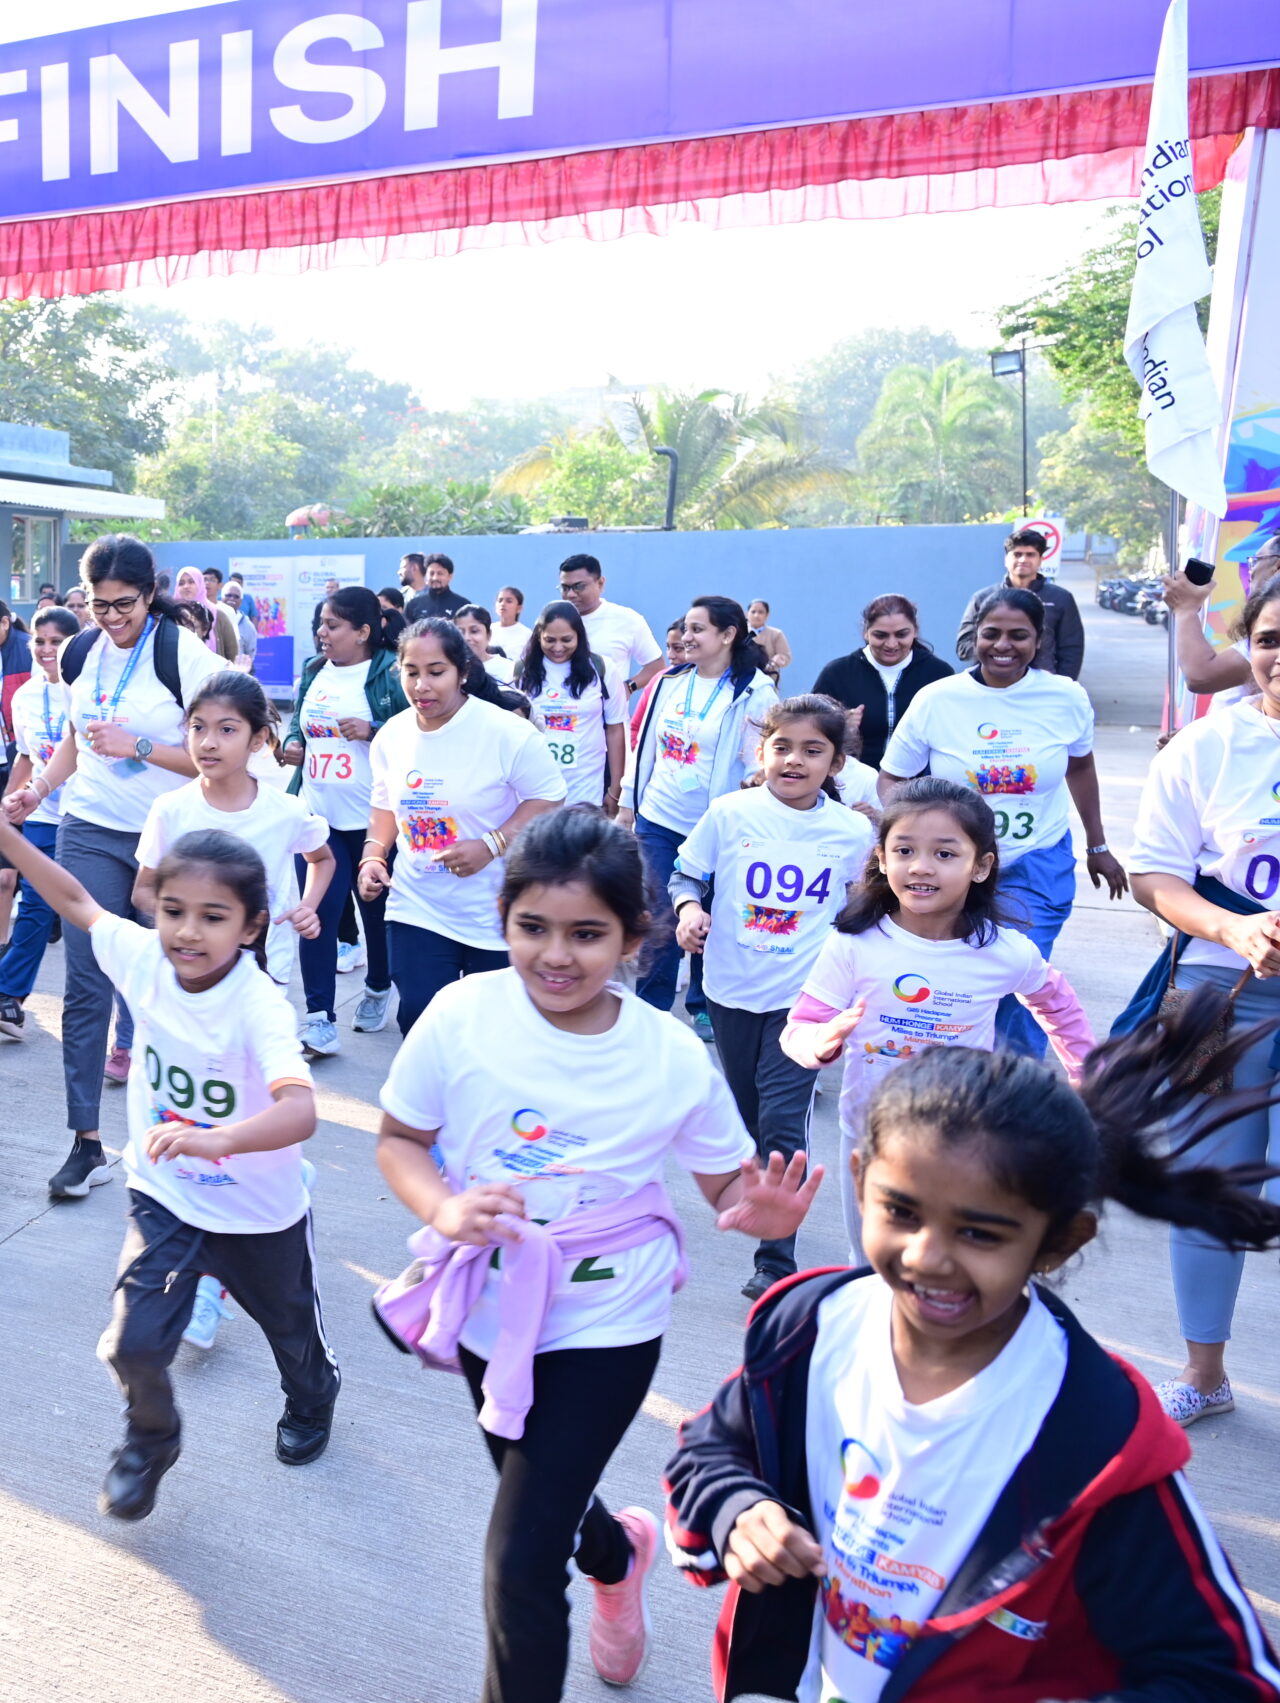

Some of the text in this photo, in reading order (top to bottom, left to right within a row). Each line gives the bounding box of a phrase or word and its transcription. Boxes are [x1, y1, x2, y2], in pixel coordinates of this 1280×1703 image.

[309, 753, 352, 779] 073
[746, 861, 832, 904] 094
[933, 995, 972, 1004] International
[934, 989, 954, 997] Global
[880, 1015, 901, 1025] HUM
[902, 1018, 932, 1031] HONGE
[891, 1026, 959, 1041] Miles to Triumph
[146, 1045, 236, 1119] 099
[886, 1503, 943, 1526] ternational
[860, 1563, 920, 1596] Triumph
